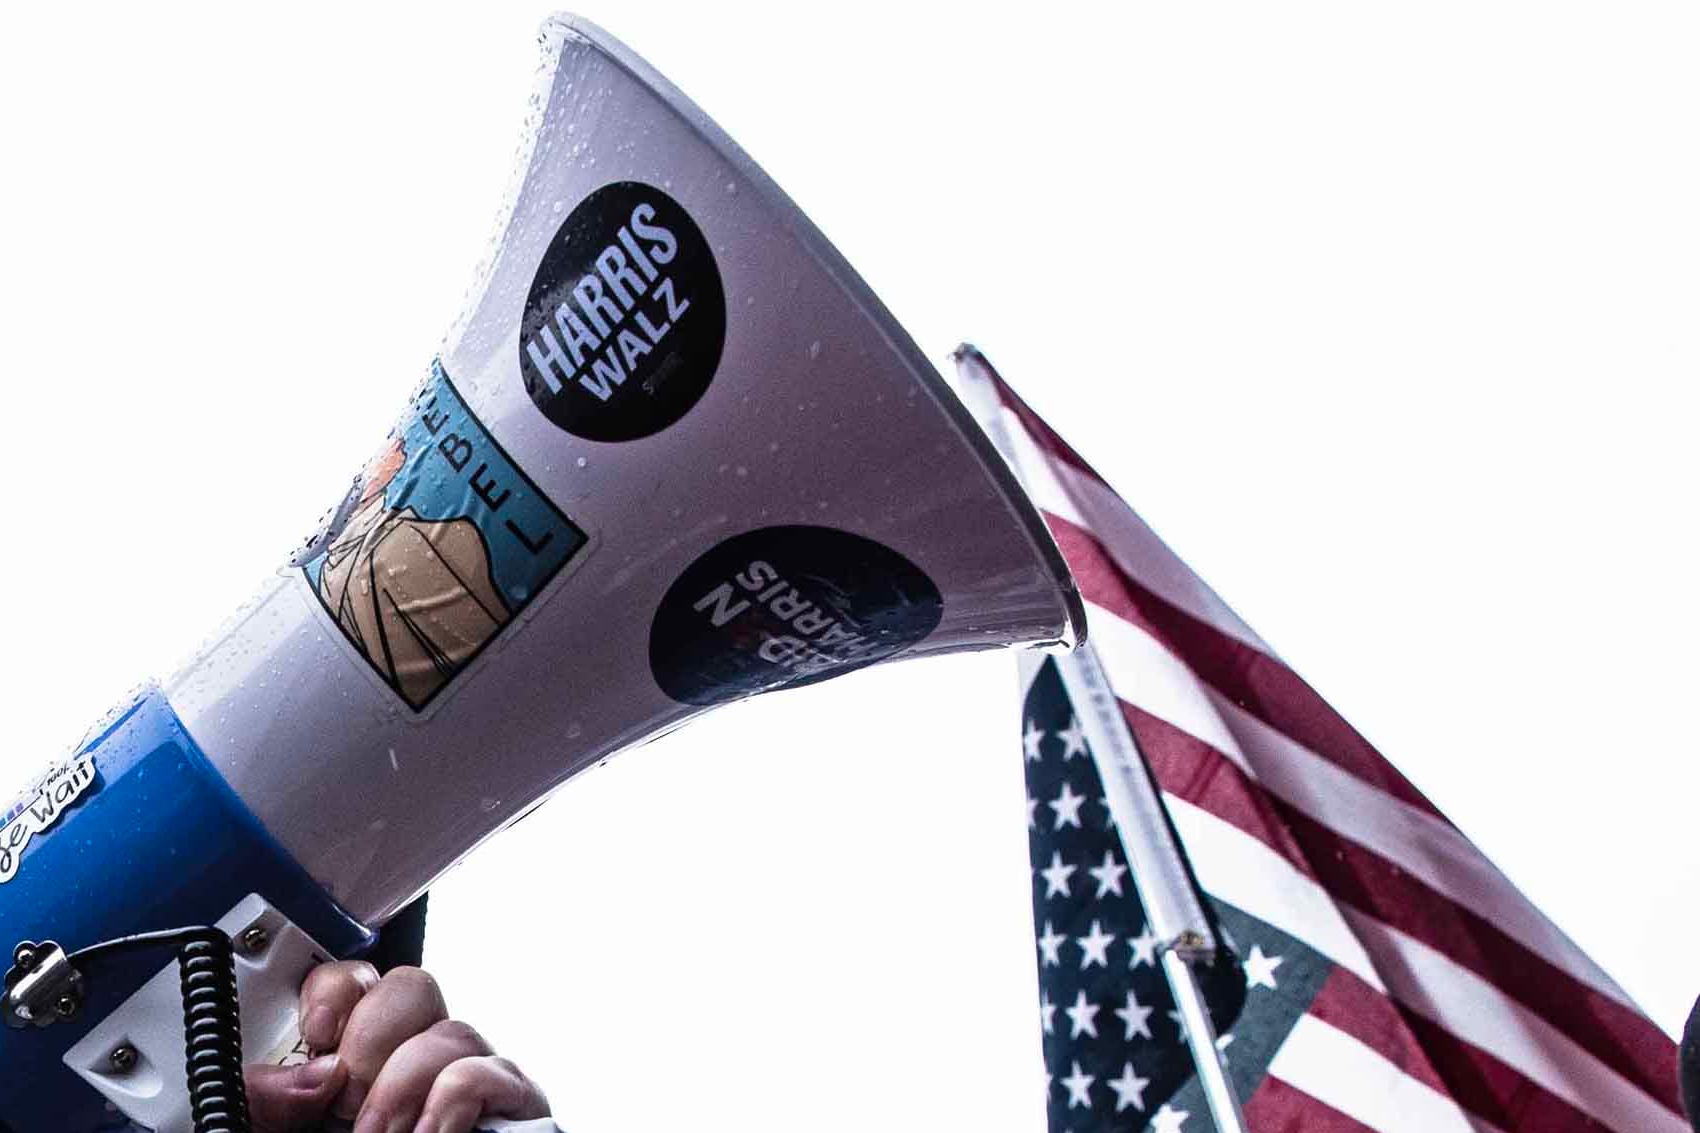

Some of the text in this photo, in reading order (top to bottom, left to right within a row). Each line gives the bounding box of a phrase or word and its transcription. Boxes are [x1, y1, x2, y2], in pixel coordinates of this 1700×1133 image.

[526, 203, 678, 395] HARRIS
[579, 277, 691, 401] WALZ
[692, 580, 840, 674] BIDN
